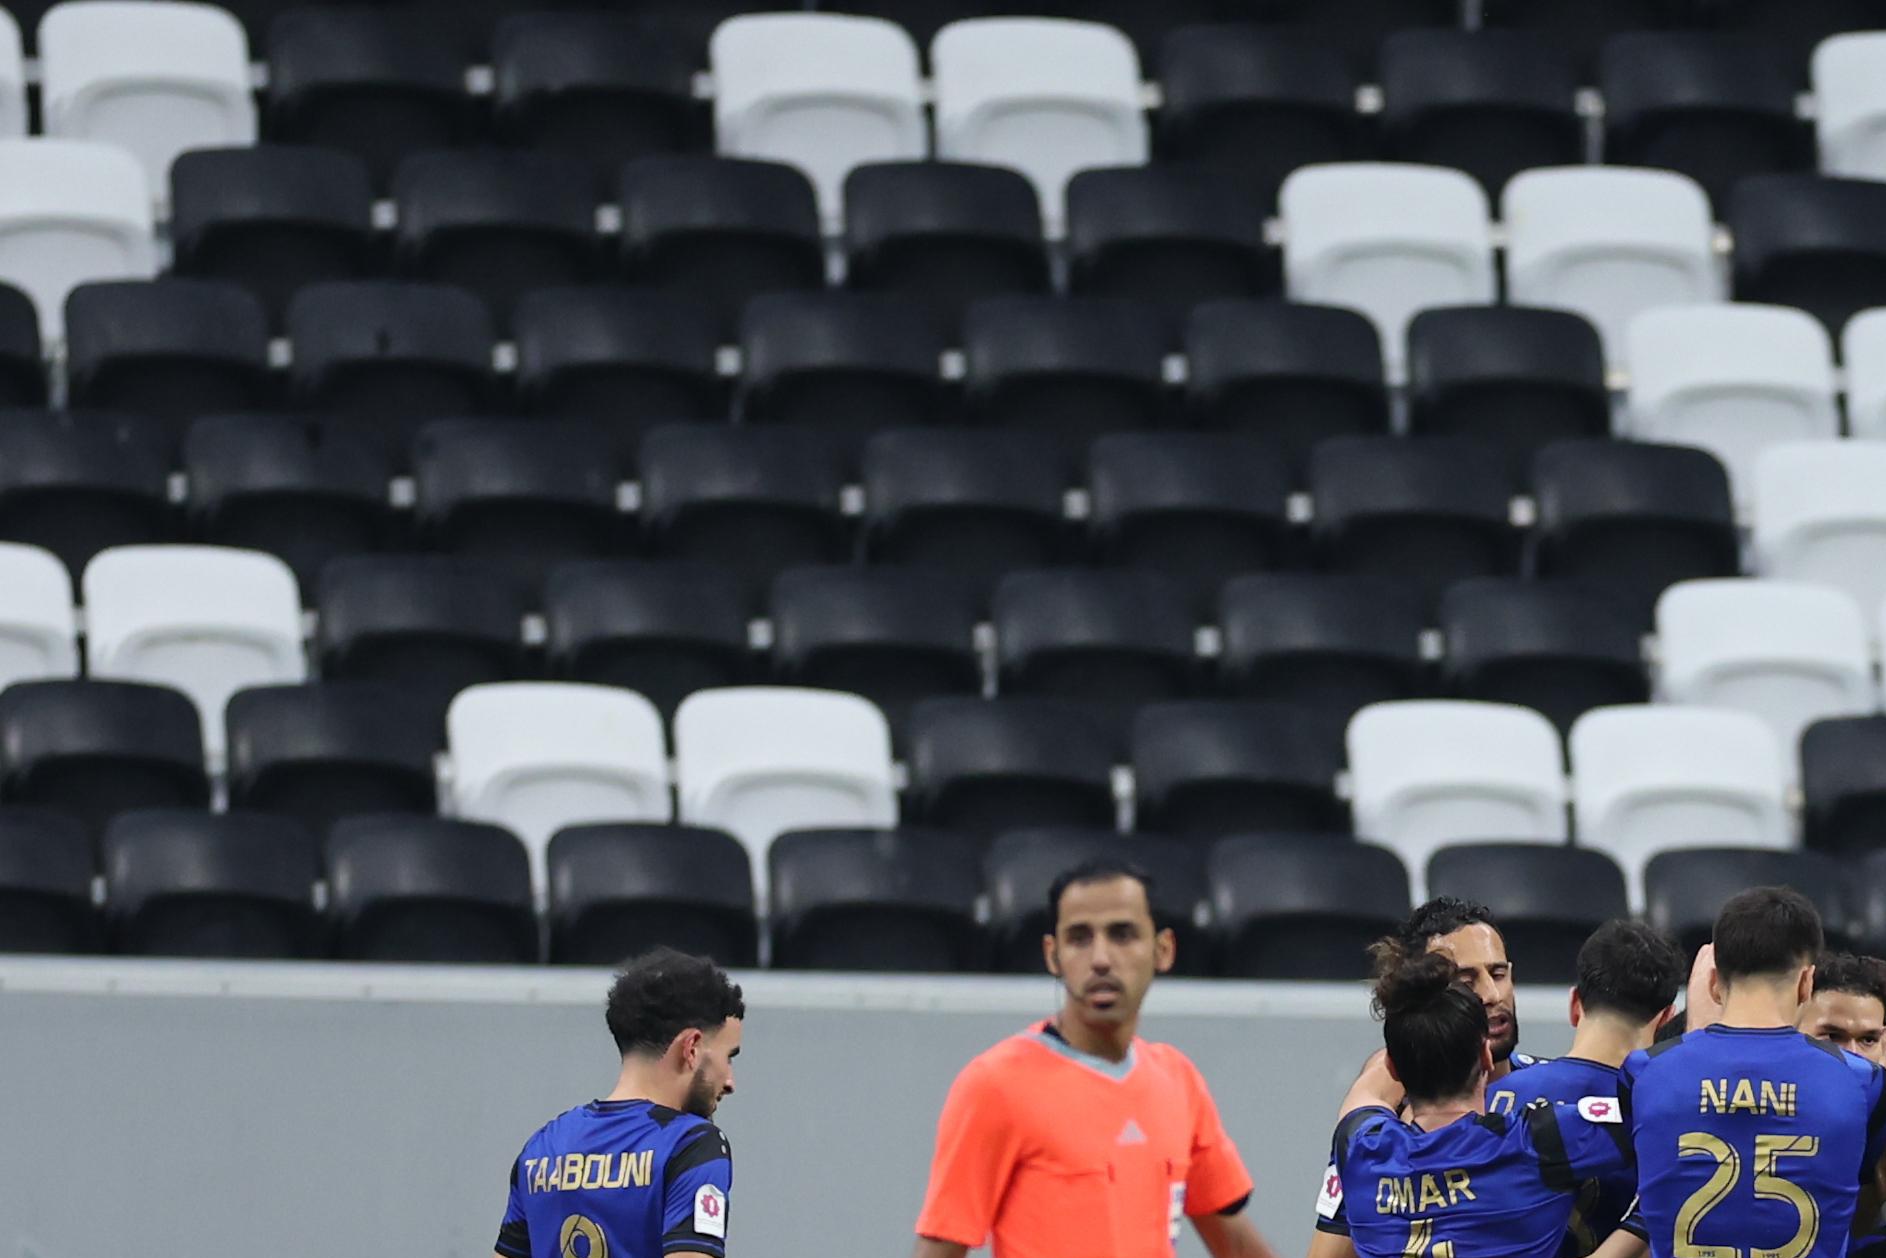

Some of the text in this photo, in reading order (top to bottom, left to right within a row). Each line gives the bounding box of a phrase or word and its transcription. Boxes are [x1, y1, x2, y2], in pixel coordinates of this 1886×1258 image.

[1700, 1078, 1797, 1117] NANI
[525, 1150, 654, 1195] TAABOUNI
[1375, 1168, 1477, 1215] OMAR
